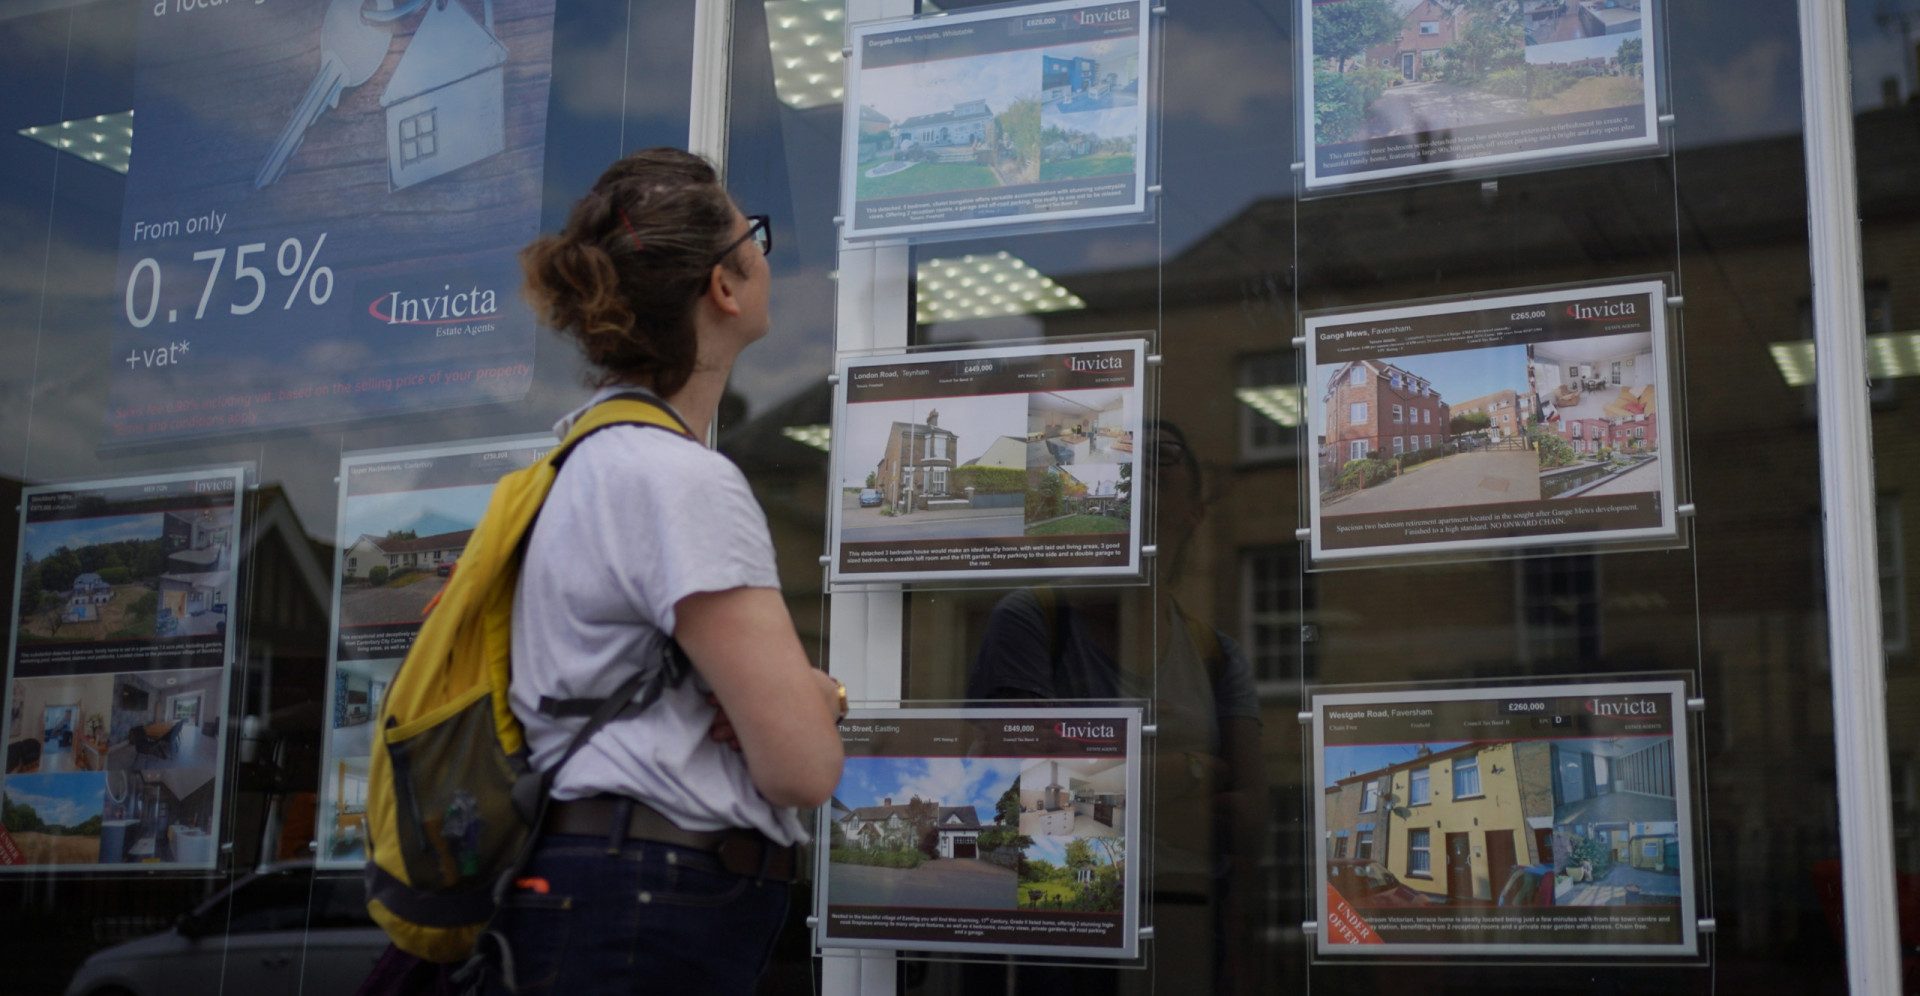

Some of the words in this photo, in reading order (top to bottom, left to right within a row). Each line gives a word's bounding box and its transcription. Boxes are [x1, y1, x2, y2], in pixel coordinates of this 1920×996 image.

[1079, 6, 1130, 25] Invicta
[134, 220, 180, 242] From
[186, 210, 227, 237] only
[125, 232, 335, 329] 0.75%
[387, 284, 498, 326] Invicta
[1574, 300, 1636, 320] Invicta
[1511, 310, 1546, 321] £265,000
[435, 325, 463, 337] Estate
[465, 322, 496, 336] Agents
[1320, 331, 1344, 343] Gange
[1346, 328, 1370, 340] Mews,
[964, 364, 993, 373] £449,000
[1071, 355, 1123, 372] Invicta
[332, 380, 351, 393] the
[354, 376, 392, 394] selling
[395, 374, 424, 389] price
[444, 370, 471, 384] your
[475, 363, 529, 381] property
[854, 371, 878, 380] London
[880, 369, 899, 379] Road,
[902, 367, 929, 378] Teynham
[194, 479, 233, 492] Invicta
[1336, 523, 1363, 534] Spacious
[1377, 520, 1404, 529] bedroom
[1405, 518, 1436, 527] retirement
[1470, 513, 1492, 522] located
[1513, 510, 1533, 520] sought
[1535, 509, 1550, 517] after
[1551, 507, 1572, 518] Gange
[1574, 505, 1594, 514] Mews
[1502, 518, 1537, 528] ONWARD
[1538, 516, 1566, 526] CHAIN.
[1007, 552, 1028, 560] parking
[1508, 702, 1544, 712] £260,000
[1592, 696, 1656, 716] Invicta
[1329, 710, 1365, 722] Westgate
[1366, 709, 1390, 720] Road,
[1555, 716, 1562, 724] D
[838, 724, 850, 733] The
[852, 725, 874, 734] Street,
[1003, 724, 1034, 733] £849,000
[1061, 721, 1114, 738] Invicta
[1337, 901, 1370, 940] UNDER
[1329, 913, 1360, 944] OFFER
